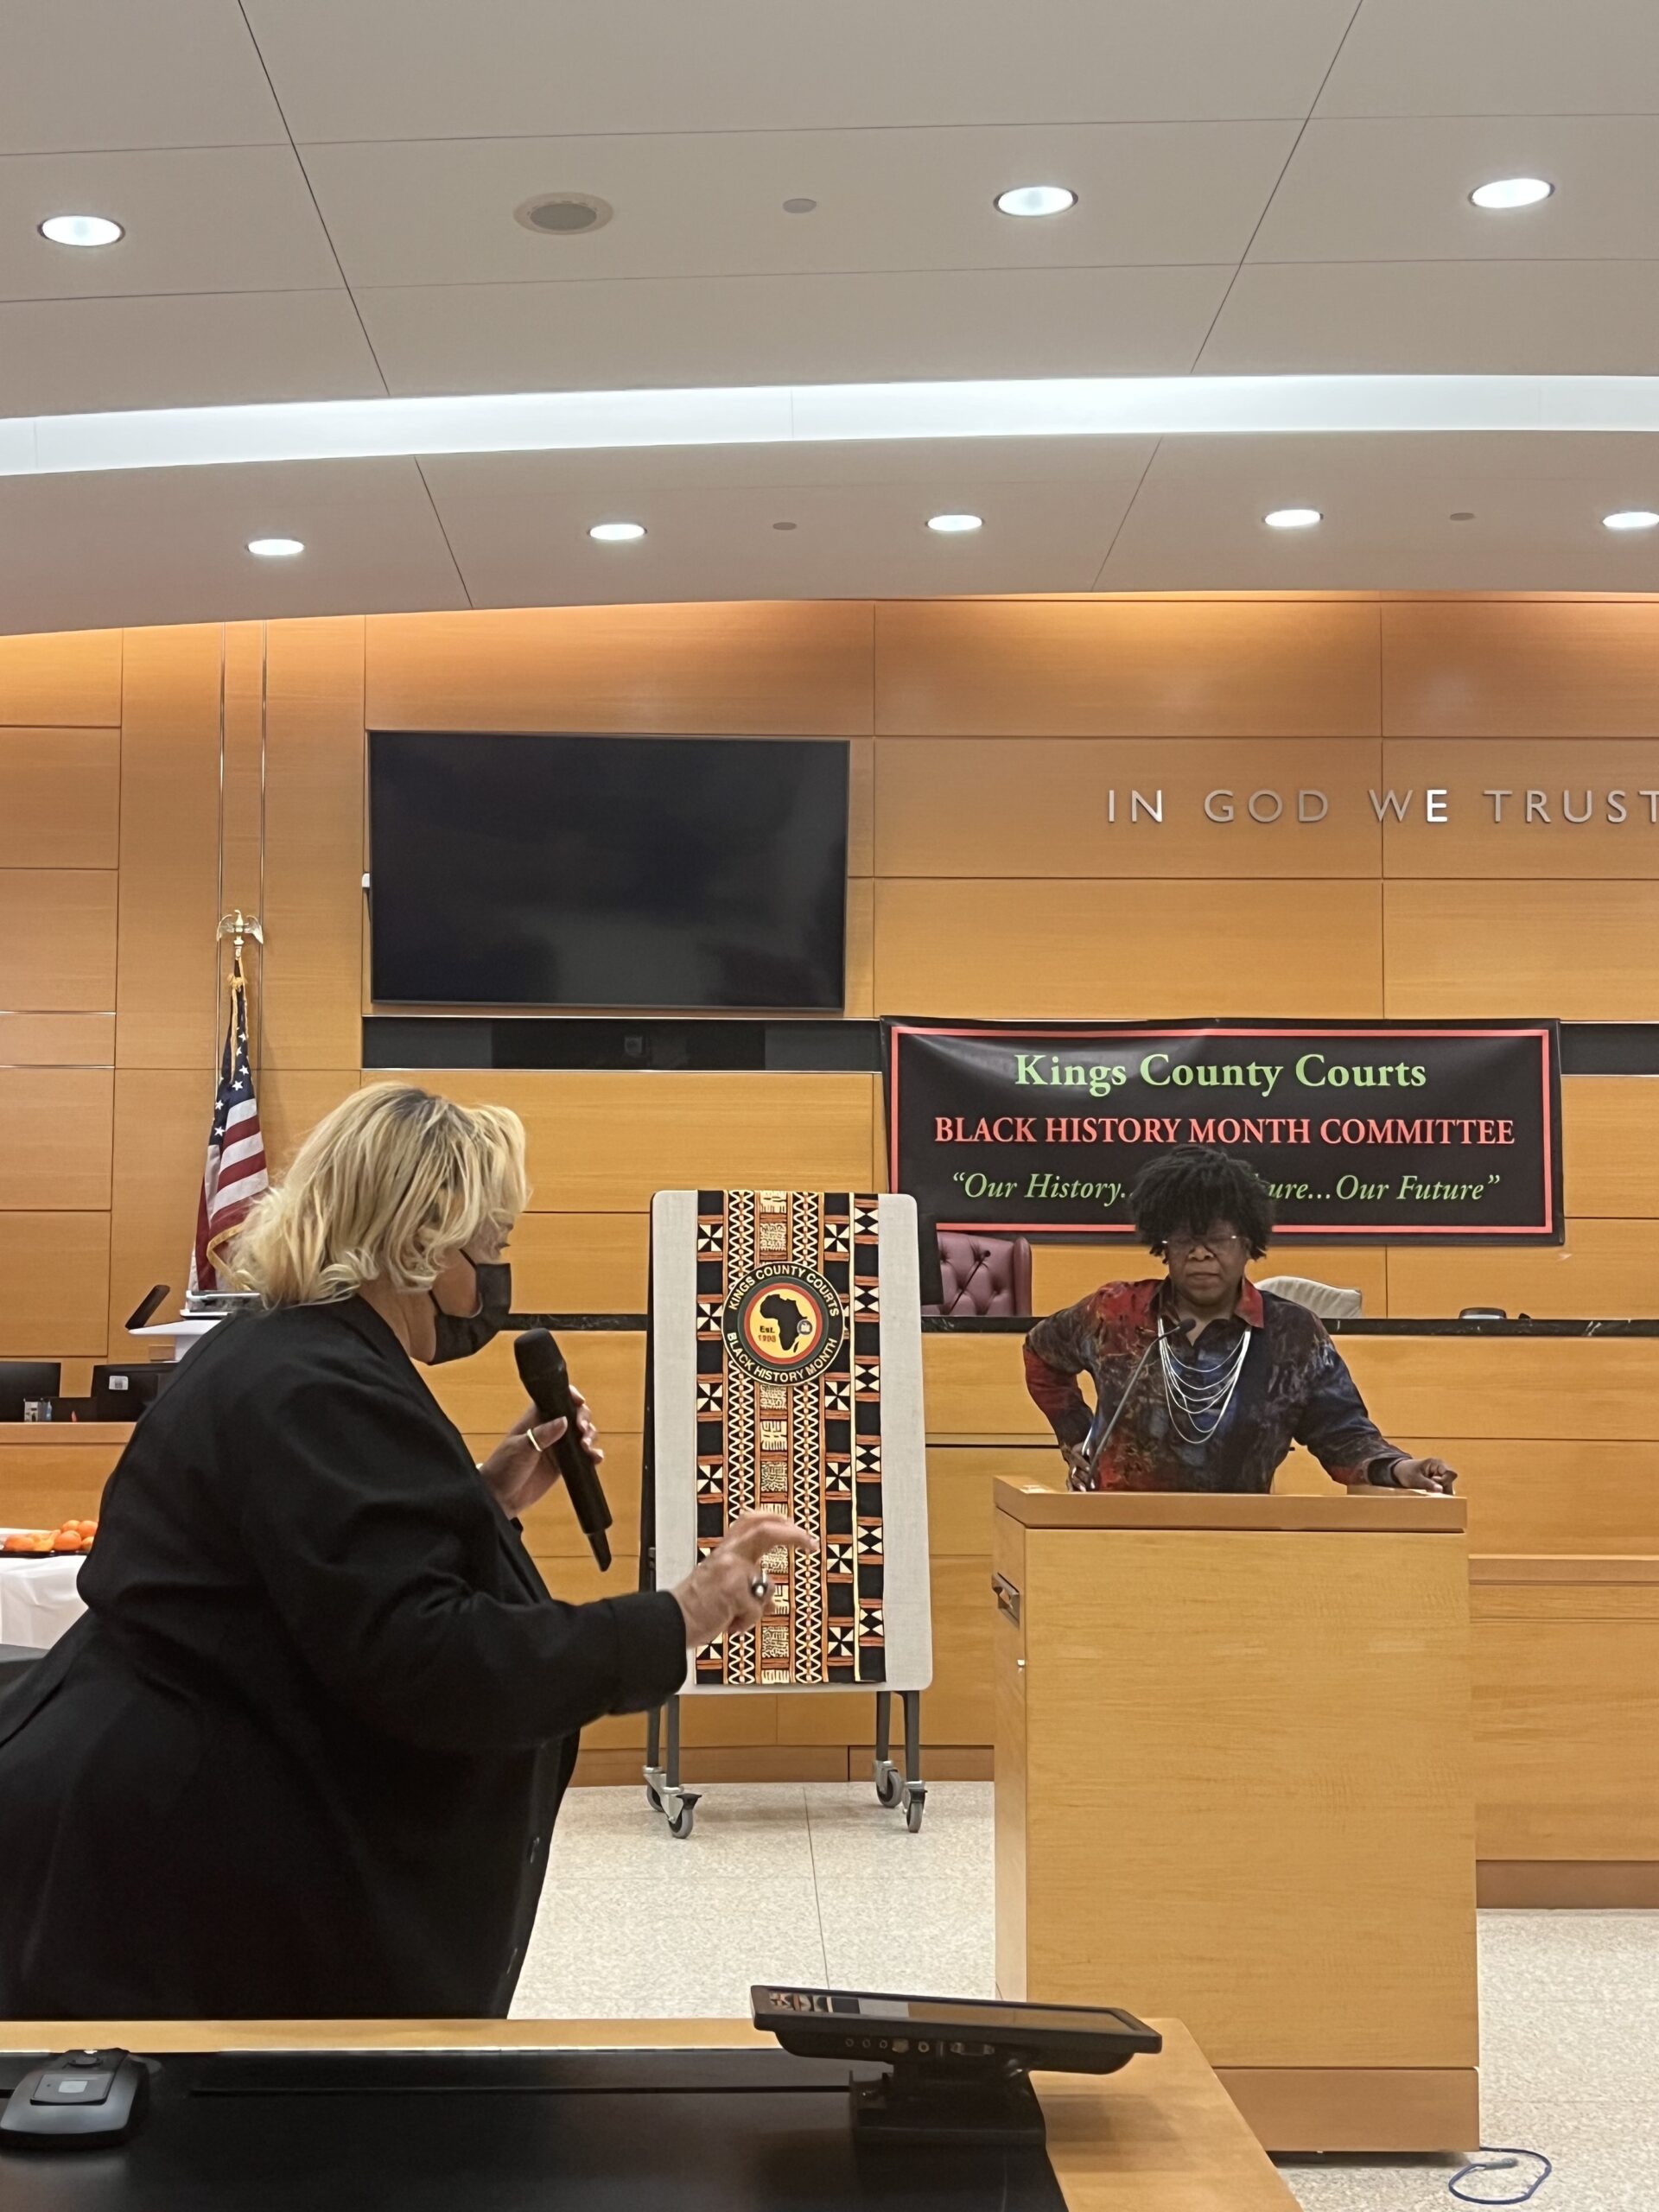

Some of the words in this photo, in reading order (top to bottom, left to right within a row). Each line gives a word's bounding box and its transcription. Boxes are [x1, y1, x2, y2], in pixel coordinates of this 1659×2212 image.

[1109, 790, 1163, 823] IN
[1203, 789, 1329, 823] GOD
[1369, 790, 1448, 823] WE
[1484, 790, 1659, 823] TRUST
[1014, 1053, 1127, 1097] Kings
[1140, 1052, 1284, 1097] County
[1295, 1053, 1427, 1088] Courts
[934, 1116, 1037, 1143] BLACK
[1045, 1116, 1182, 1143] HISTORY
[1188, 1118, 1311, 1144] MONTH
[1319, 1118, 1515, 1146] COMMITTEE
[728, 1276, 755, 1311] KINGS
[755, 1264, 806, 1279] COUNTY
[806, 1272, 840, 1317] COURTS
[727, 1332, 753, 1371] BLACK
[753, 1367, 805, 1382] HISTORY
[805, 1337, 838, 1375] MONTH
